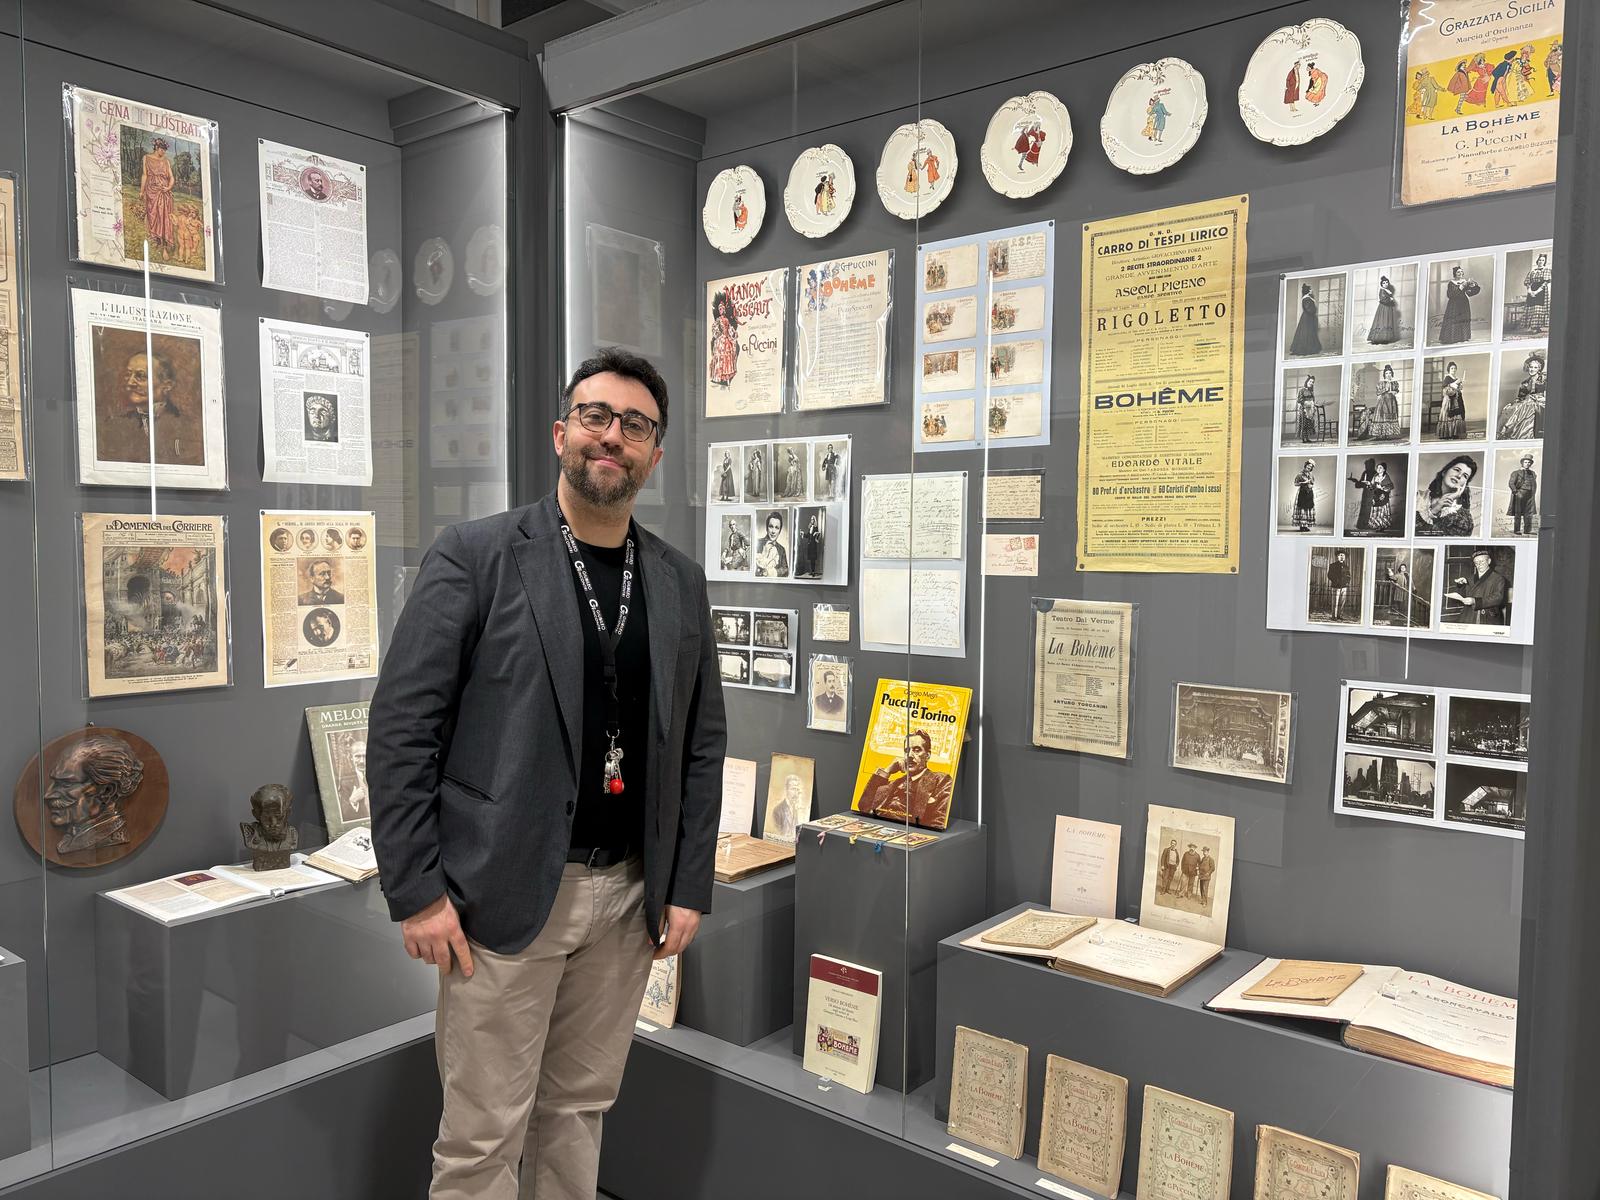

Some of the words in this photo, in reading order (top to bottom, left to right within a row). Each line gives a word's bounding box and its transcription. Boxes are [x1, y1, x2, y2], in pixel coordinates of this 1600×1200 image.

[1475, 132, 1528, 148] PUCCINI
[1098, 242, 1134, 256] CARRO
[1138, 239, 1149, 250] DI
[1154, 234, 1185, 247] TESPI
[1190, 226, 1229, 241] LIRICO
[723, 277, 768, 301] MANON
[1115, 284, 1157, 298] ASCOLI
[1162, 276, 1206, 292] PICENO
[132, 316, 162, 324] ITALANA
[1097, 302, 1226, 332] RIGOLETTO
[1094, 386, 1224, 410] BOHÊME
[1111, 458, 1160, 468] EDOARDO
[1164, 457, 1203, 466] VITALE
[112, 520, 162, 531] DOMENICA
[172, 520, 212, 532] CORRIERE
[1048, 637, 1064, 655] La
[1070, 638, 1116, 659] Bohème
[880, 693, 920, 710] Puccini
[911, 709, 918, 718] e
[920, 706, 956, 724] Torino
[1426, 994, 1515, 1020] LEONCAVALLO
